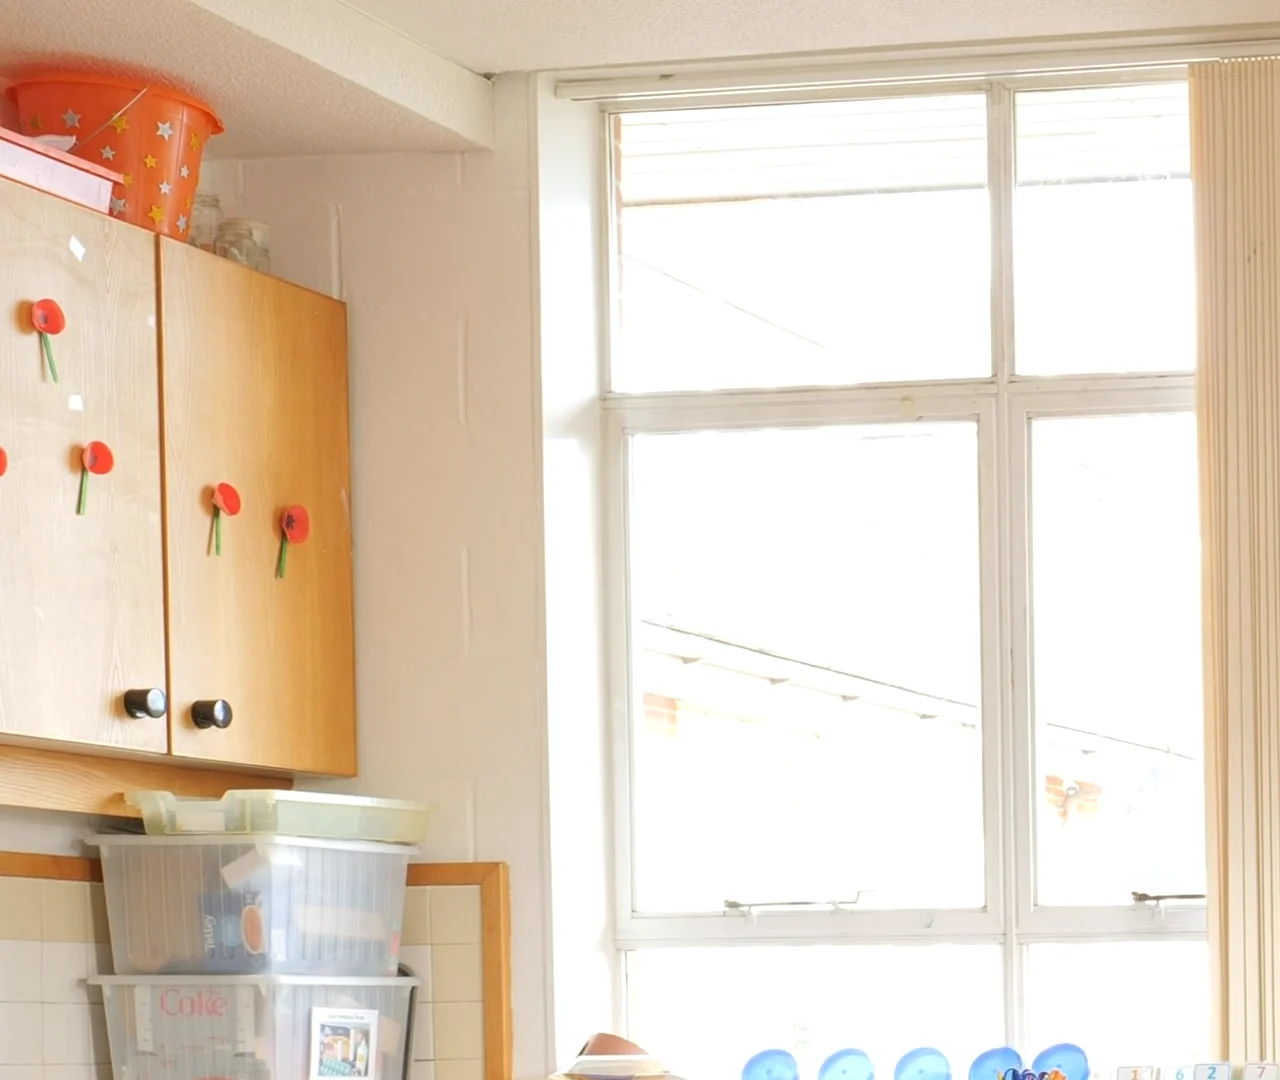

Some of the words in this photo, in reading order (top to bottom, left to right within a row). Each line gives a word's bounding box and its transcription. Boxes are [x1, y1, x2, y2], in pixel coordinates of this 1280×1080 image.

[160, 988, 226, 1017] Coke
[1130, 1069, 1139, 1080] 1
[1175, 1068, 1184, 1080] 6
[1207, 1066, 1217, 1080] 2
[1257, 1066, 1266, 1079] 7
